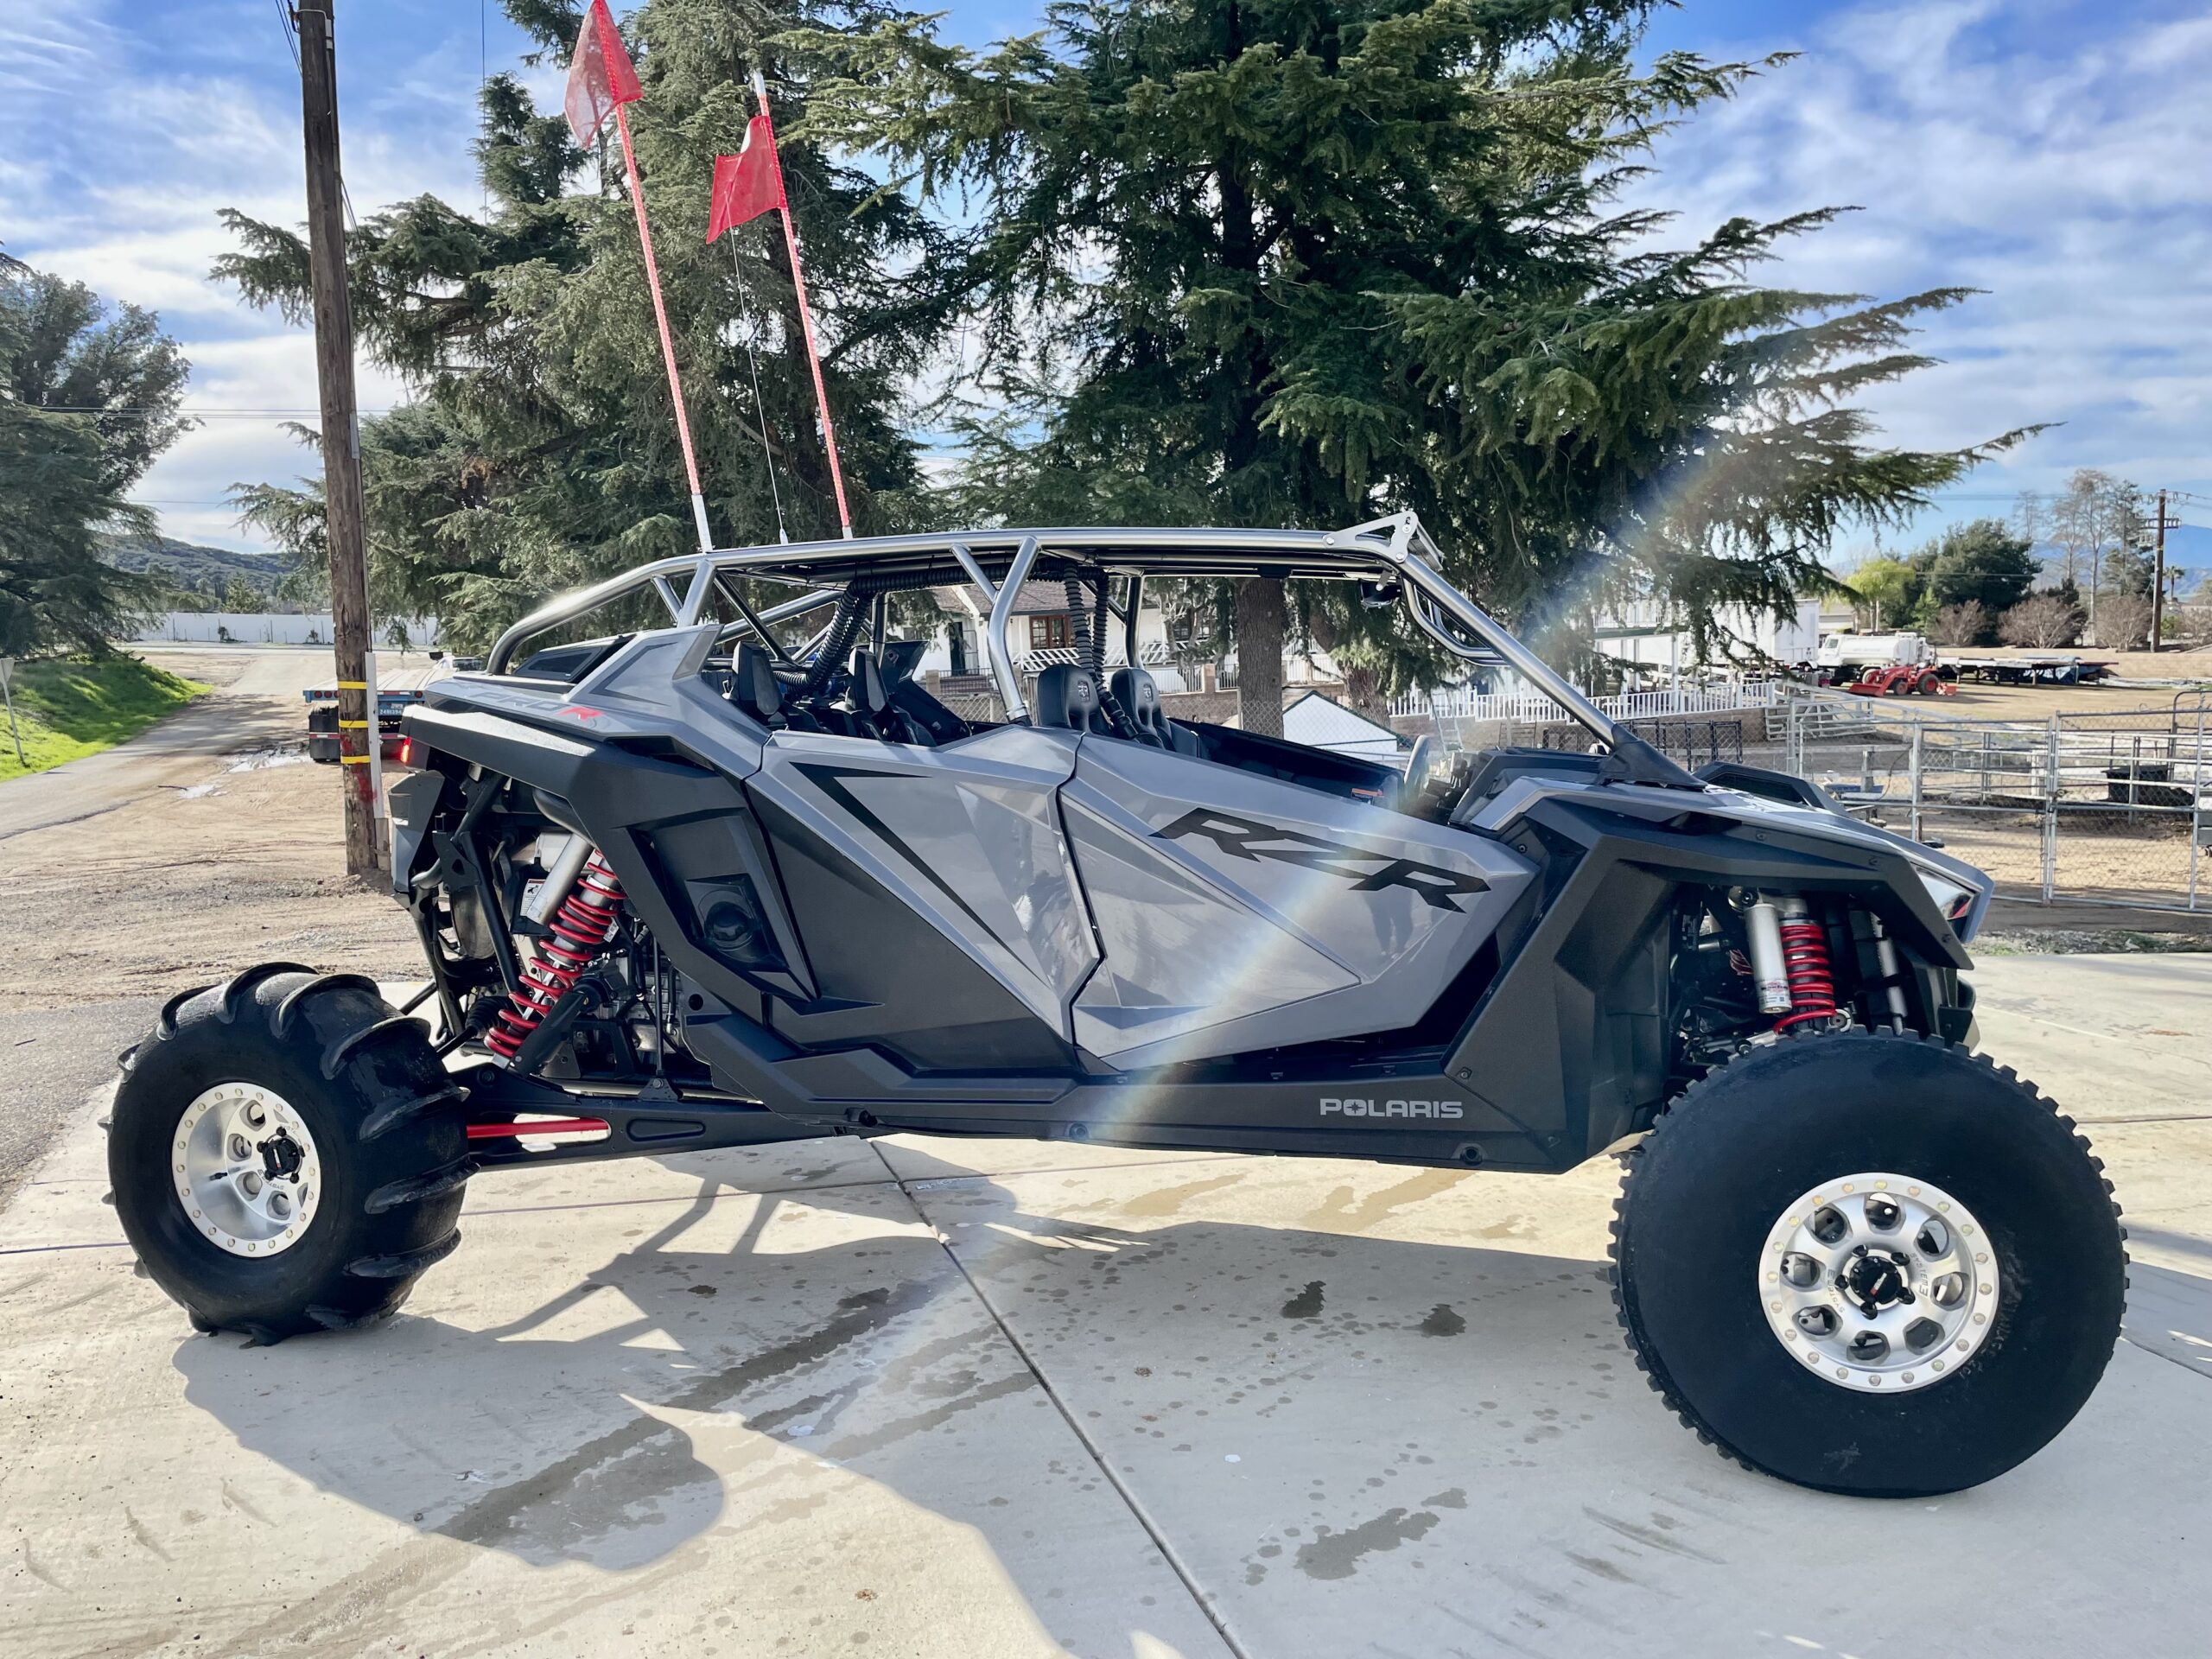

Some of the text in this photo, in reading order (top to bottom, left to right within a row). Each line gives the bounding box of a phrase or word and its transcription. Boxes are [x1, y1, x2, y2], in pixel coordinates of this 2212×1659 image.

[469, 691, 606, 721] PRO R
[1147, 806, 1491, 914] RZR
[1319, 1097, 1464, 1119] POLARIS
